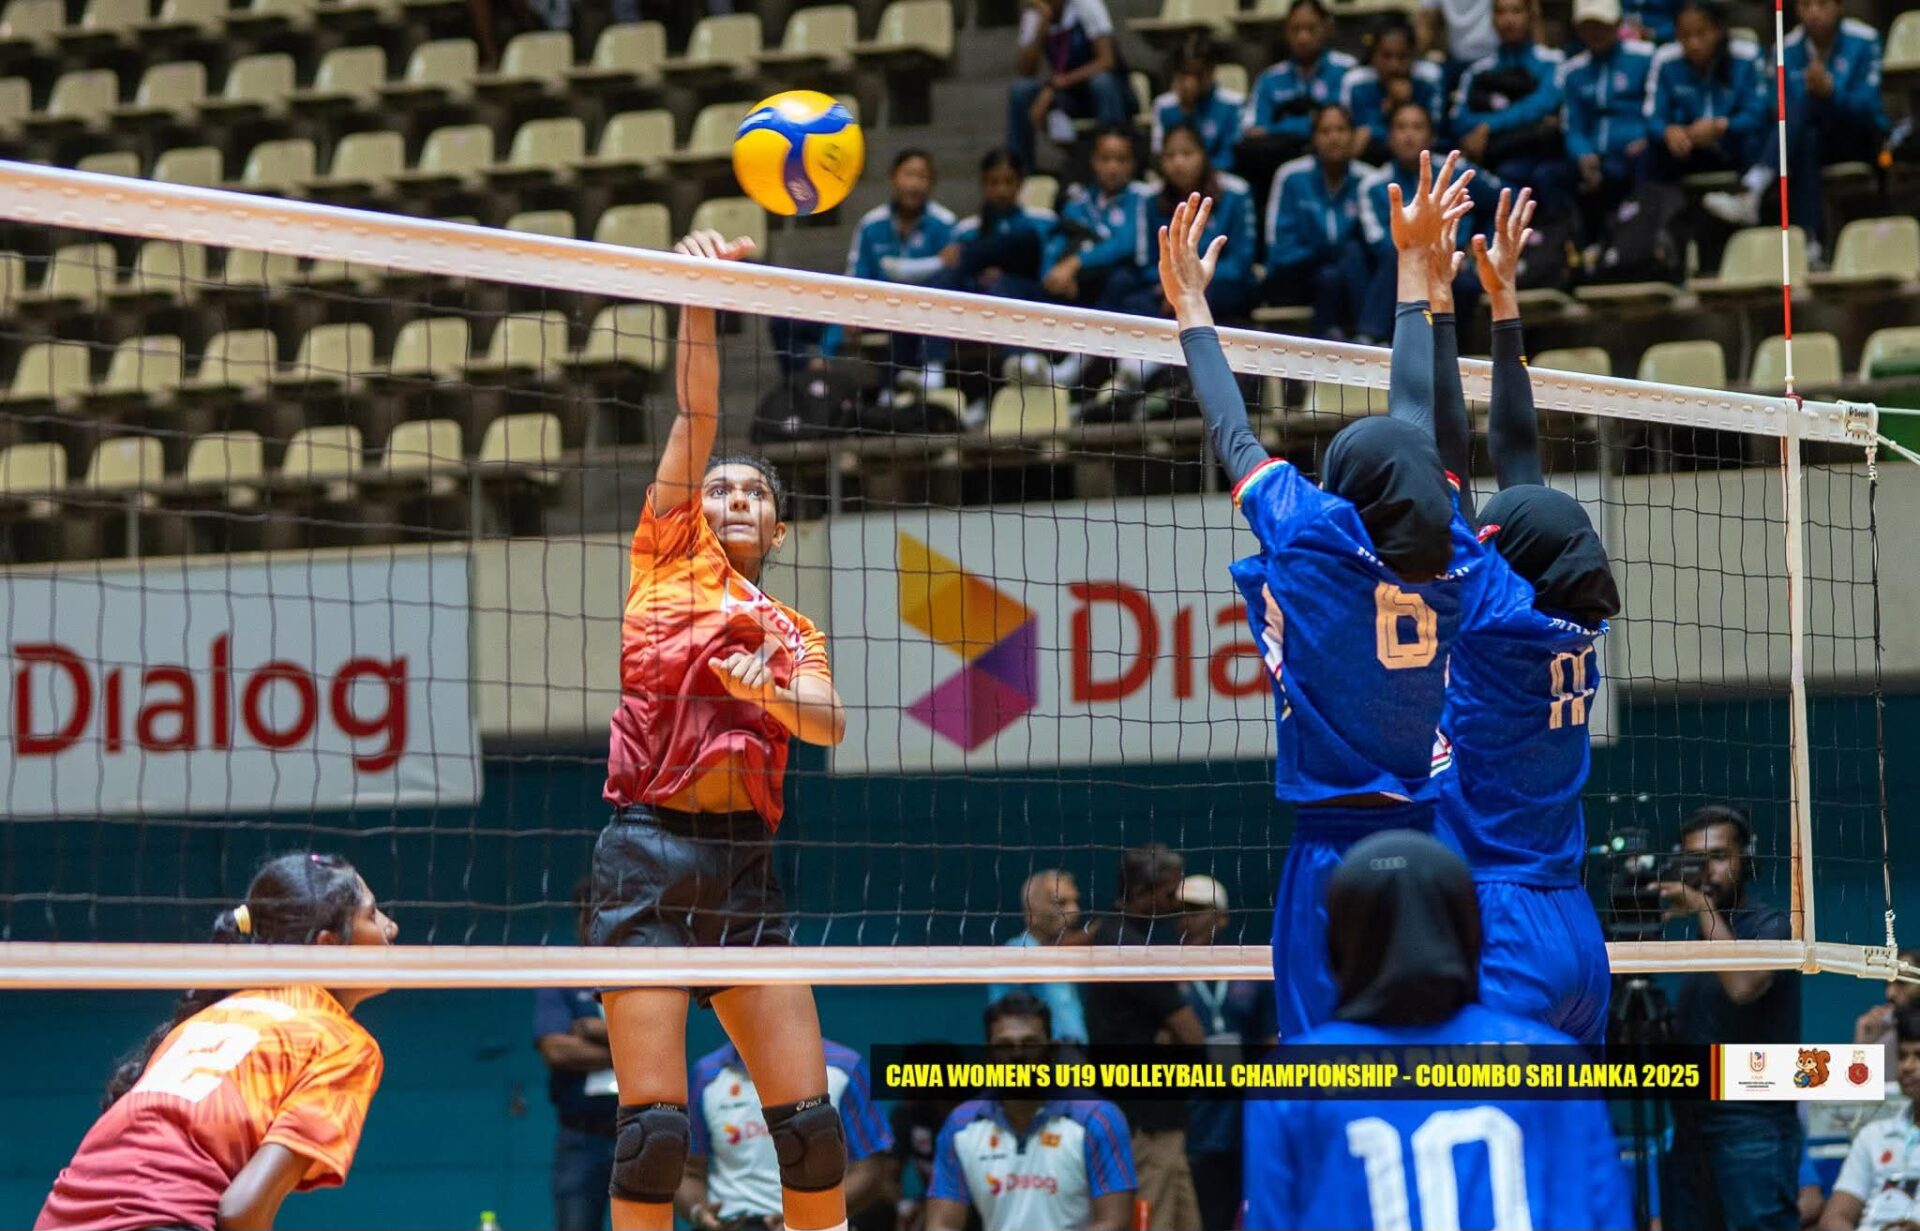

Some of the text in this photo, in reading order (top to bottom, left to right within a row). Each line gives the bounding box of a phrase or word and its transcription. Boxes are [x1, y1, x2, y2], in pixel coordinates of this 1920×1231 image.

[14, 633, 409, 773] Dialog
[1070, 580, 1274, 700] Dia
[1345, 1105, 1533, 1231] 10
